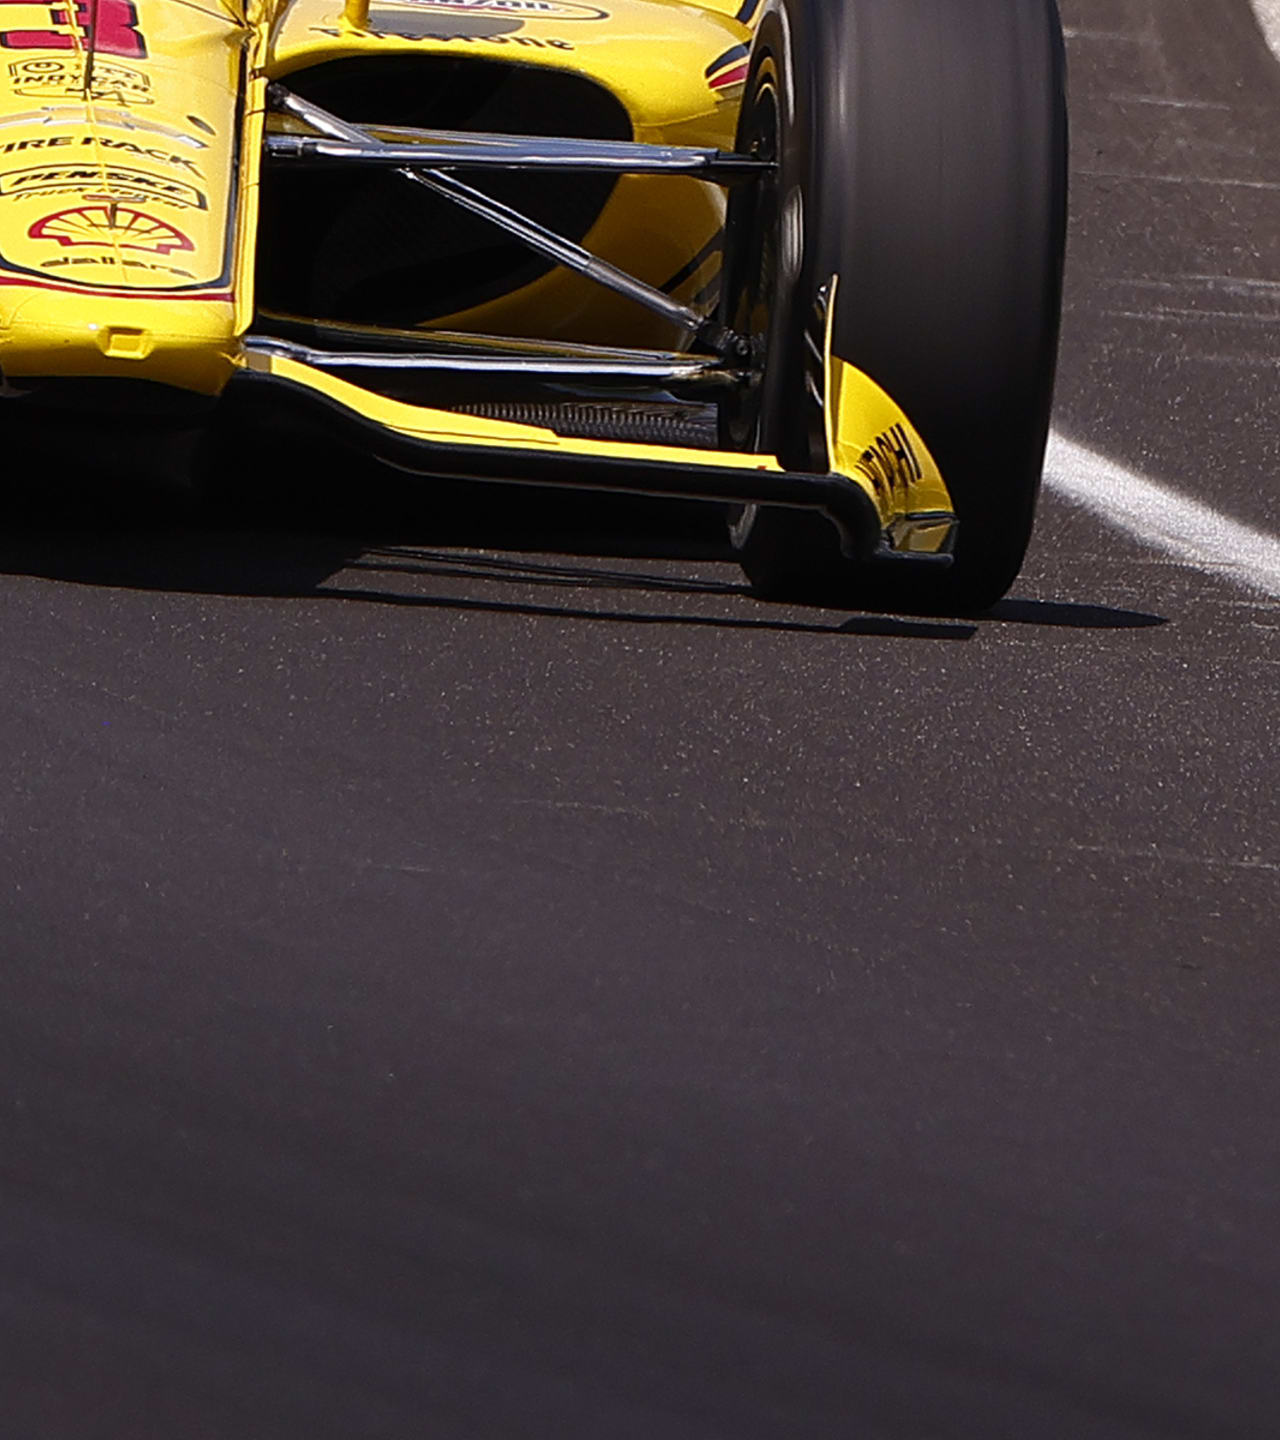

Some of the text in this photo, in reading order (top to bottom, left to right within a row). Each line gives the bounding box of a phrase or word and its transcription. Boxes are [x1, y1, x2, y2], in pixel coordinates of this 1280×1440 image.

[80, 136, 208, 182] RACK
[8, 170, 194, 197] PENSKE
[39, 256, 198, 281] dallara
